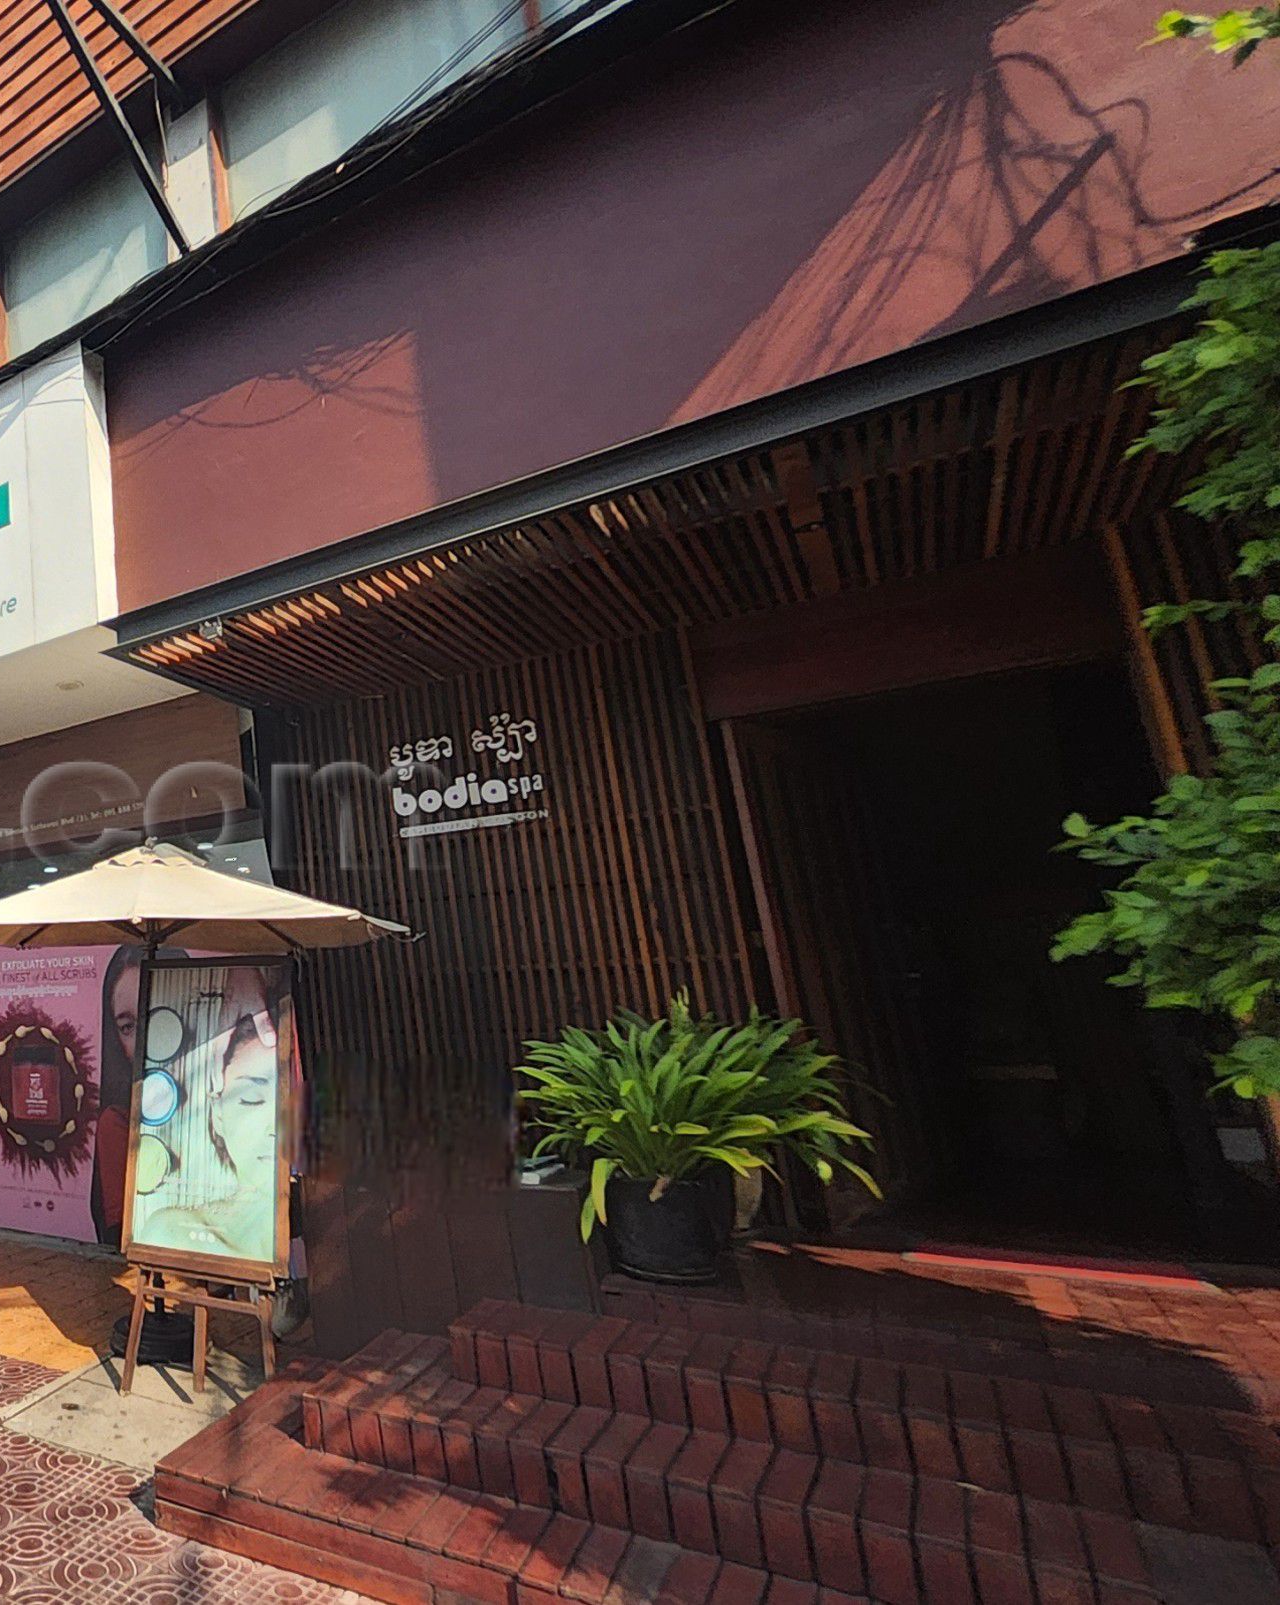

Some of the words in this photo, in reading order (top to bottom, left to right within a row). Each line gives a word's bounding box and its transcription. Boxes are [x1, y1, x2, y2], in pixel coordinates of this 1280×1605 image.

[392, 772, 508, 816] bodia
[508, 773, 543, 799] spa
[1, 959, 46, 971] EXFOLIATE
[47, 957, 71, 968] YOUR
[72, 956, 95, 966] SKIN
